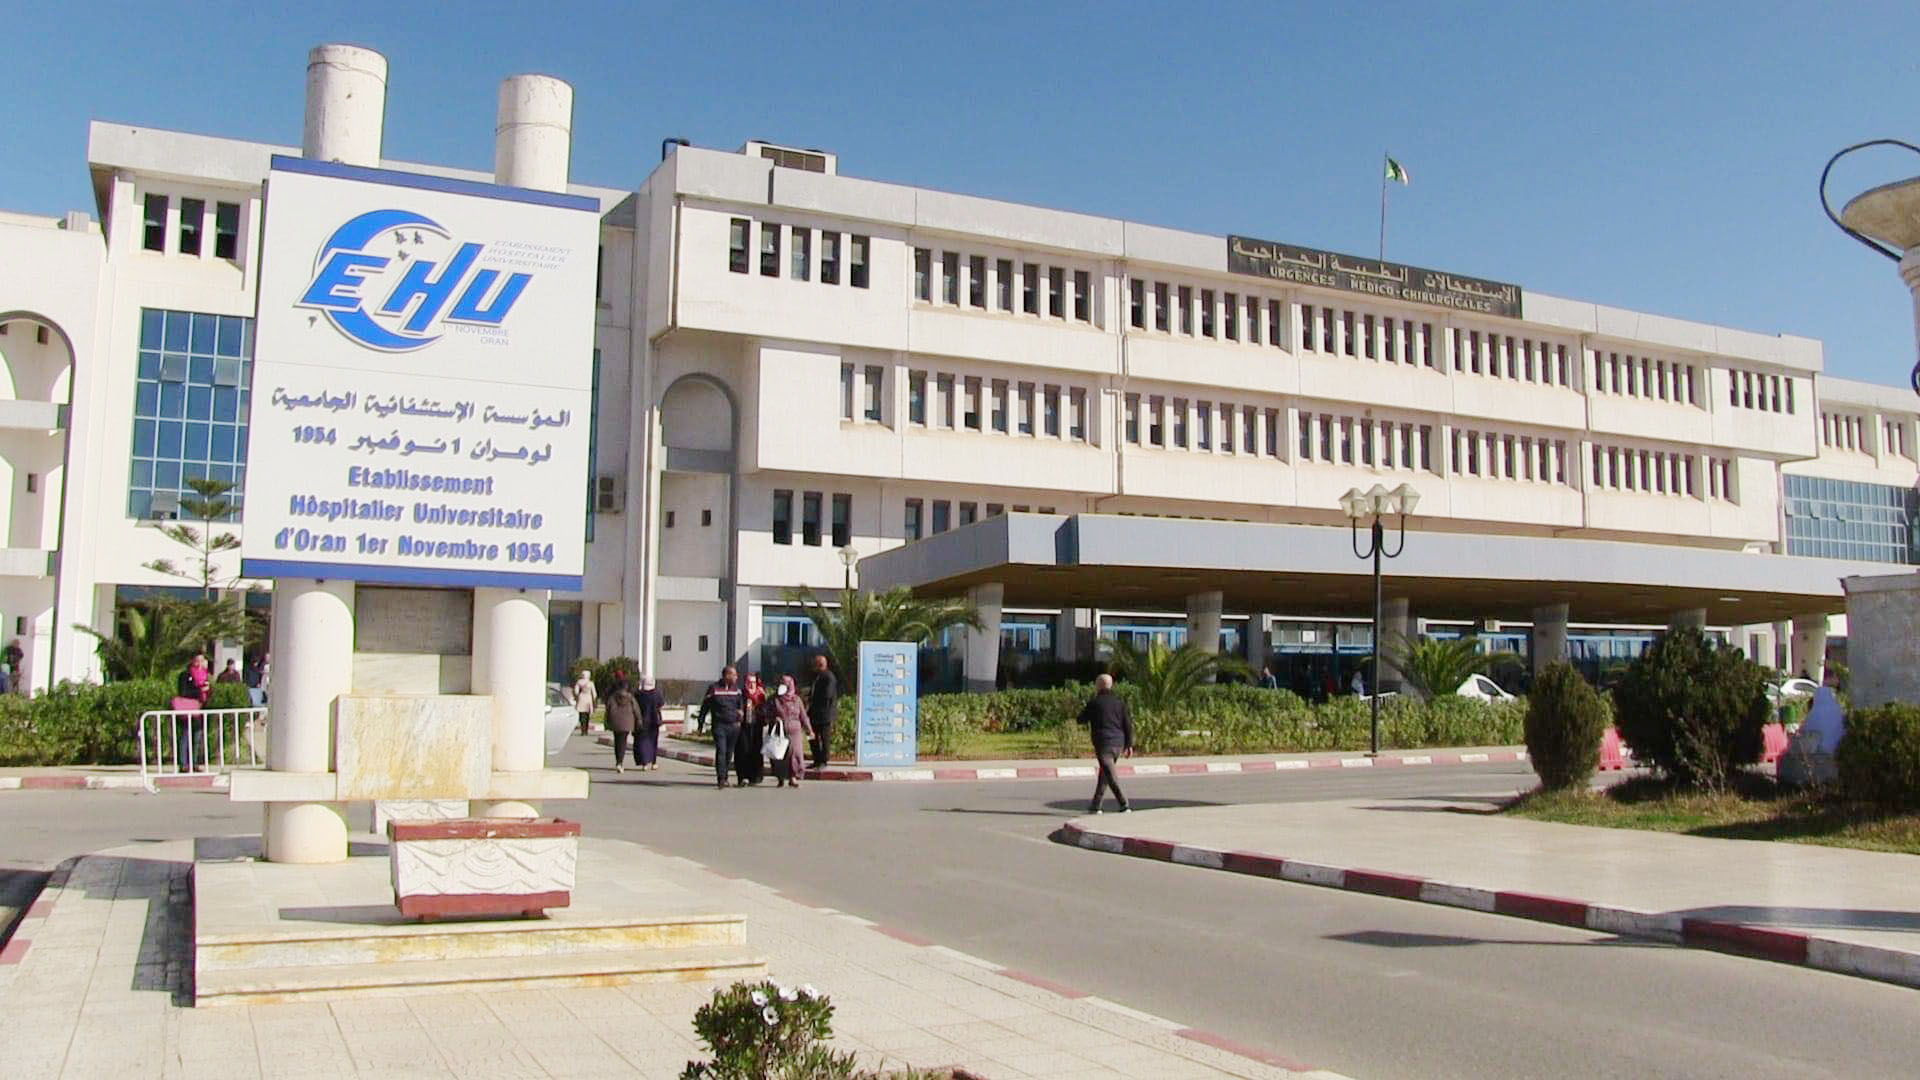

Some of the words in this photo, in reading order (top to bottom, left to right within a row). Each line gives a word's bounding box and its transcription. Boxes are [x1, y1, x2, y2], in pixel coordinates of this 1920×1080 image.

[1231, 236, 1327, 271] الجراحية
[298, 242, 534, 333] EHU
[1269, 265, 1336, 286] URGENCES
[455, 325, 510, 338] NOVEMBRE
[480, 336, 510, 346] ORAN
[271, 386, 357, 413] الجامعية
[483, 405, 571, 430] المؤسسة
[292, 424, 337, 446] 1954
[347, 429, 447, 457] نوفمبر
[451, 437, 461, 455] 1
[470, 438, 552, 466] لوهران
[347, 465, 494, 496] Etablissement
[289, 494, 405, 523] Hôspitalier
[413, 502, 543, 531] Universitaire
[274, 526, 347, 553] d'Oran
[355, 532, 389, 555] 1er
[397, 534, 499, 561] Novembre
[505, 541, 554, 565] 1954
